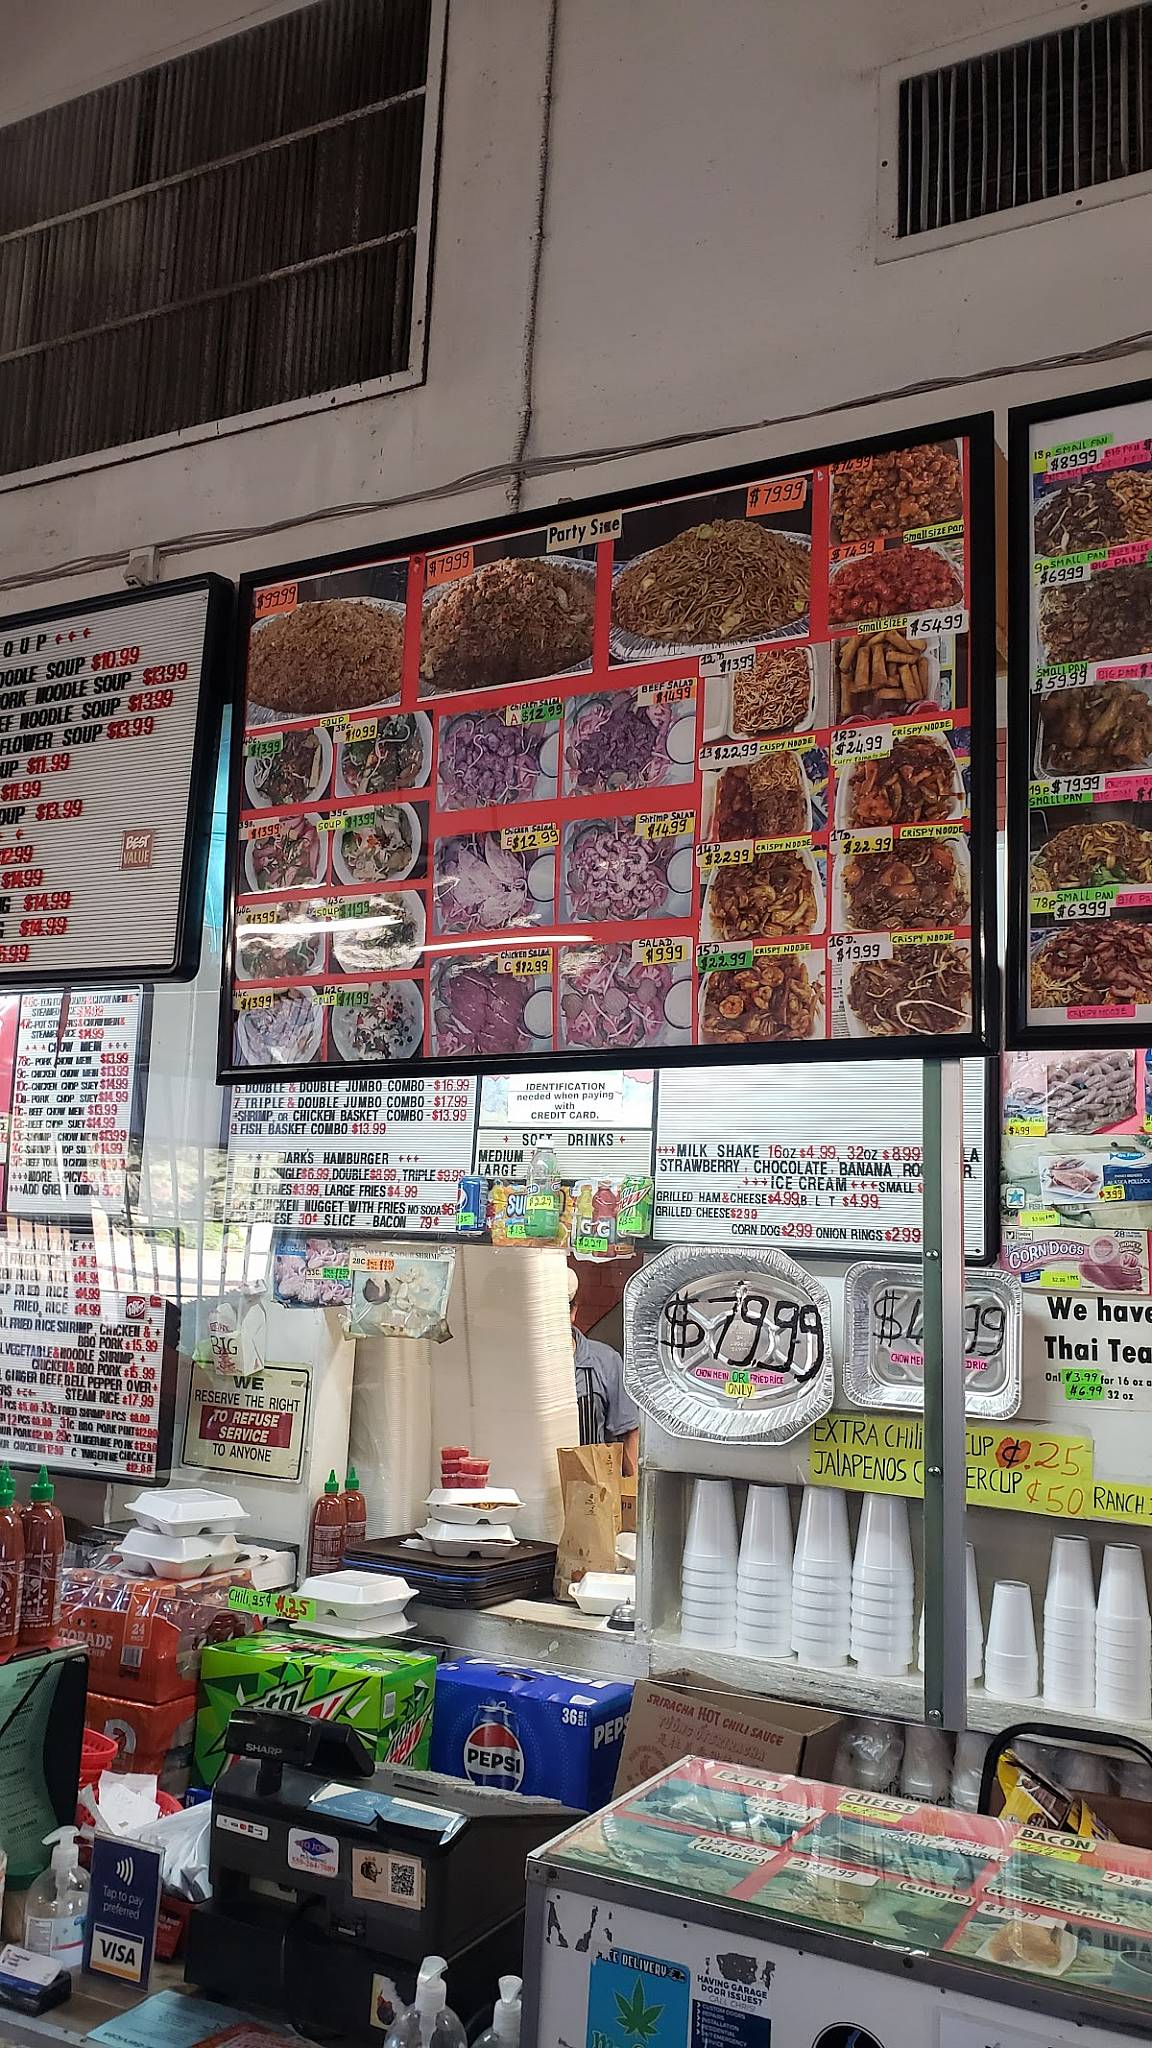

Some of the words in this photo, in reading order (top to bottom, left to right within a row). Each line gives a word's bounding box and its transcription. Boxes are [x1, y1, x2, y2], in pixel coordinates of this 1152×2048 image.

[749, 480, 804, 508] $79.99
[549, 525, 588, 547] Party
[590, 515, 620, 537] Size
[1050, 554, 1082, 569] SMALL
[1086, 550, 1106, 562] PAN
[46, 656, 86, 681] SOUP
[91, 645, 141, 672] $10.99
[1068, 661, 1088, 674] PAN
[35, 679, 90, 705] NOODLE
[93, 671, 132, 693] SOUP
[641, 682, 667, 694] BEEF
[19, 704, 74, 730] NOODLE
[81, 696, 121, 721] SOUP
[62, 723, 103, 748] SOUP
[834, 734, 884, 756] $24.99
[1050, 775, 1101, 795] $79.99
[1065, 792, 1084, 802] PAN
[125, 834, 151, 851] BEST
[512, 830, 560, 850] $12.99
[843, 836, 893, 855] $22.99
[123, 849, 150, 865] VALUE
[1056, 891, 1091, 904] SMALL
[1094, 890, 1114, 901] PAN
[645, 944, 684, 965] $9.99
[700, 951, 747, 972] $22.99
[836, 943, 881, 963] $19.99
[299, 1080, 341, 1093] DOUBLE
[345, 1080, 383, 1093] JUMBO
[387, 1079, 425, 1092] COMBO
[525, 1082, 606, 1092] IDENTIFICATION
[244, 1097, 285, 1109] TRIPLE
[297, 1096, 339, 1109] DOUBLE
[342, 1095, 381, 1109] JUMBO
[387, 1095, 425, 1108] COMBO
[516, 1092, 551, 1102] needed
[553, 1091, 580, 1101] when
[581, 1091, 615, 1102] paying
[277, 1113, 288, 1122] OR
[292, 1109, 336, 1122] CHICKEN
[340, 1109, 378, 1122] BASKET
[386, 1109, 424, 1122] COMBO
[530, 1111, 566, 1121] CREDIT
[568, 1110, 600, 1120] CARD.
[554, 1102, 575, 1111] with
[240, 1123, 263, 1135] FISH
[268, 1123, 307, 1135] BASKET
[310, 1123, 348, 1135] COMBO
[351, 1122, 387, 1135] $13.99
[567, 1133, 614, 1147] DRINKS
[323, 1152, 390, 1165] HAMBURGER
[478, 1149, 524, 1163] MEDIUM
[677, 1145, 708, 1158] MILK
[717, 1145, 761, 1158] SHAKE
[478, 1163, 518, 1177] LARGE
[659, 1159, 740, 1174] STRAWBERRY
[753, 1160, 828, 1175] CHOCOLATE
[838, 1161, 893, 1177] BANANA
[324, 1184, 355, 1197] LARGE
[358, 1184, 386, 1197] FRIES
[387, 1185, 418, 1198] $4.99
[770, 1175, 796, 1191] ICE
[798, 1176, 848, 1192] CREAM
[878, 1181, 915, 1194] SMALL
[655, 1191, 694, 1203] GRILLED
[698, 1191, 721, 1203] HAM
[304, 1200, 344, 1214] NUGGET
[349, 1201, 374, 1214] WITH
[377, 1201, 406, 1215] FRIES
[407, 1203, 418, 1215] NO
[420, 1204, 441, 1216] SODA
[655, 1206, 692, 1219] GRILLED
[695, 1207, 731, 1219] CHEESE
[323, 1214, 356, 1227] SLICE
[731, 1222, 758, 1236] CORN
[759, 1223, 782, 1237] DOG
[815, 1227, 848, 1241] ONION
[850, 1227, 884, 1242] RINGS
[1113, 1230, 1126, 1239] 28
[1008, 1244, 1050, 1270] CORN
[1048, 1240, 1085, 1257] DOGS
[1046, 1296, 1088, 1322] We
[1096, 1296, 1152, 1325] have
[100, 1324, 141, 1338] CHICKEN
[99, 1336, 124, 1350] PORK
[210, 1336, 238, 1355] BIG
[1043, 1335, 1099, 1362] Thai
[1107, 1338, 1152, 1365] Tea
[97, 1363, 122, 1377] PORK
[732, 1371, 747, 1383] OR
[87, 1377, 123, 1391] PEPPER
[126, 1379, 152, 1392] OVER
[233, 1375, 265, 1391] WE
[1100, 1374, 1115, 1386] for
[1117, 1375, 1130, 1387] 16
[1132, 1378, 1144, 1388] oz
[65, 1389, 97, 1403] STEAM
[99, 1391, 120, 1404] RICE
[726, 1383, 754, 1398] ONLY
[1107, 1389, 1121, 1401] 32
[1122, 1391, 1134, 1402] oz
[194, 1389, 241, 1406] RESERVE
[244, 1393, 265, 1409] THE
[269, 1397, 301, 1413] RIGHT
[213, 1408, 228, 1423] TO
[231, 1411, 280, 1429] REFUSE
[218, 1426, 270, 1444] SERVICE
[813, 1416, 879, 1447] EXTRA
[212, 1442, 227, 1457] TO
[229, 1445, 272, 1463] ANYONE
[1092, 1486, 1145, 1515] RANCH
[130, 1623, 146, 1636] 24
[560, 1705, 578, 1726] 36
[645, 1692, 696, 1719] SRIRACHA
[697, 1705, 722, 1727] HOT
[721, 1716, 749, 1737] CHILI
[749, 1725, 785, 1747] SAUCE
[244, 1741, 283, 1756] SHARP
[466, 1746, 522, 1774] PEPSI
[717, 1770, 780, 1791] EXTRA
[845, 1792, 916, 1815] CHEESE
[1020, 1828, 1091, 1851] BACON
[102, 1885, 119, 1899] Tap
[119, 1889, 128, 1901] to
[128, 1896, 144, 1907] pay
[899, 1882, 975, 1906] (single)
[102, 1901, 141, 1921] preferred
[99, 1938, 137, 1967] VISA
[620, 1951, 668, 1978] DELIVERY
[697, 1973, 730, 1990] HAVING
[731, 1982, 768, 2000] GARAGE
[700, 1983, 727, 1998] DOOR
[727, 1989, 763, 2007] ISSUES?
